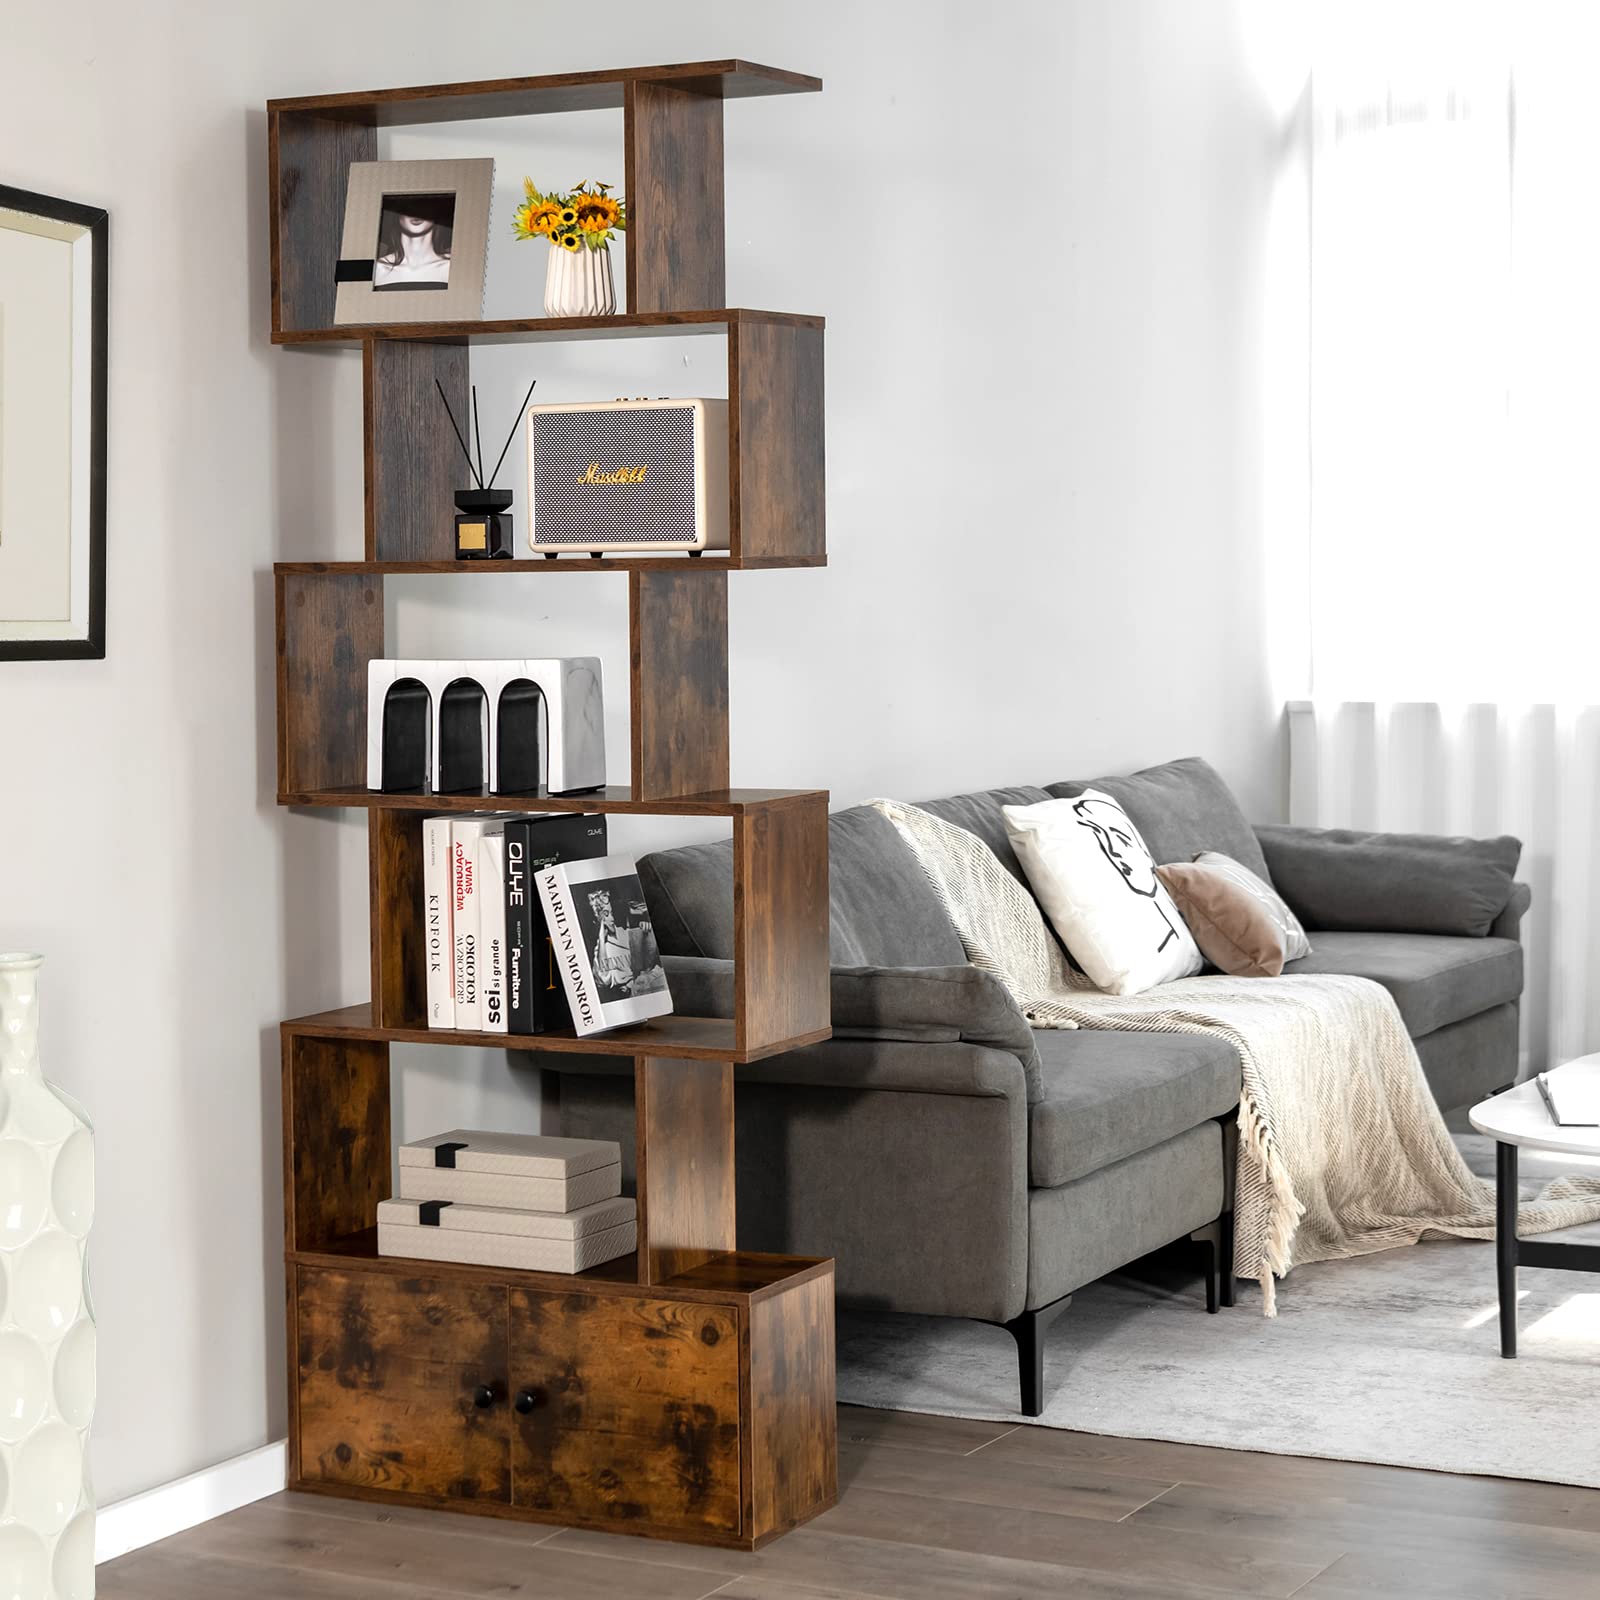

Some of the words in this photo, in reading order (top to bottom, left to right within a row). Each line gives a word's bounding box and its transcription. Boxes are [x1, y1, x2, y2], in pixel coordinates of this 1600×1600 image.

[464, 860, 473, 894] ŚWIAT
[429, 895, 441, 972] KINFOLK
[544, 874, 574, 951] MARILYN
[566, 954, 595, 1027] MONROE
[456, 947, 465, 1004] GRZEGORZ
[491, 939, 502, 976] grande
[511, 947, 521, 1009] Furniture
[484, 989, 501, 1024] sei
[492, 978, 501, 988] si
